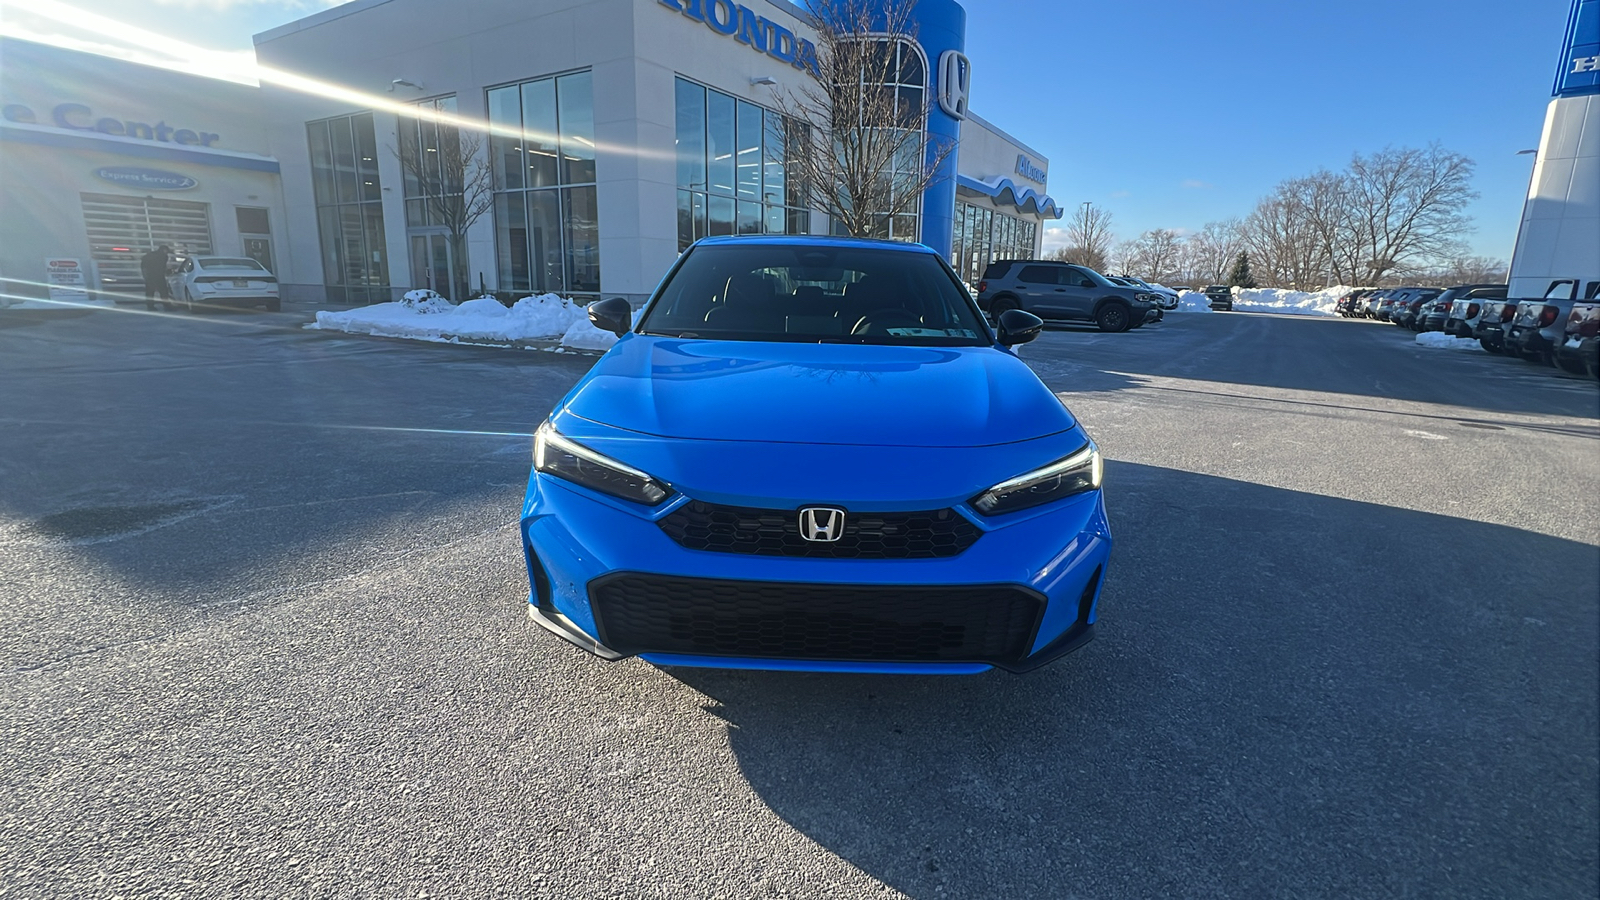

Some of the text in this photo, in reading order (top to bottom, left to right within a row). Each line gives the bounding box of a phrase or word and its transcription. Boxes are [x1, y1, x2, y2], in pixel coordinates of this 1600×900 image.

[52, 102, 220, 147] Center
[100, 169, 178, 185] Express Service
